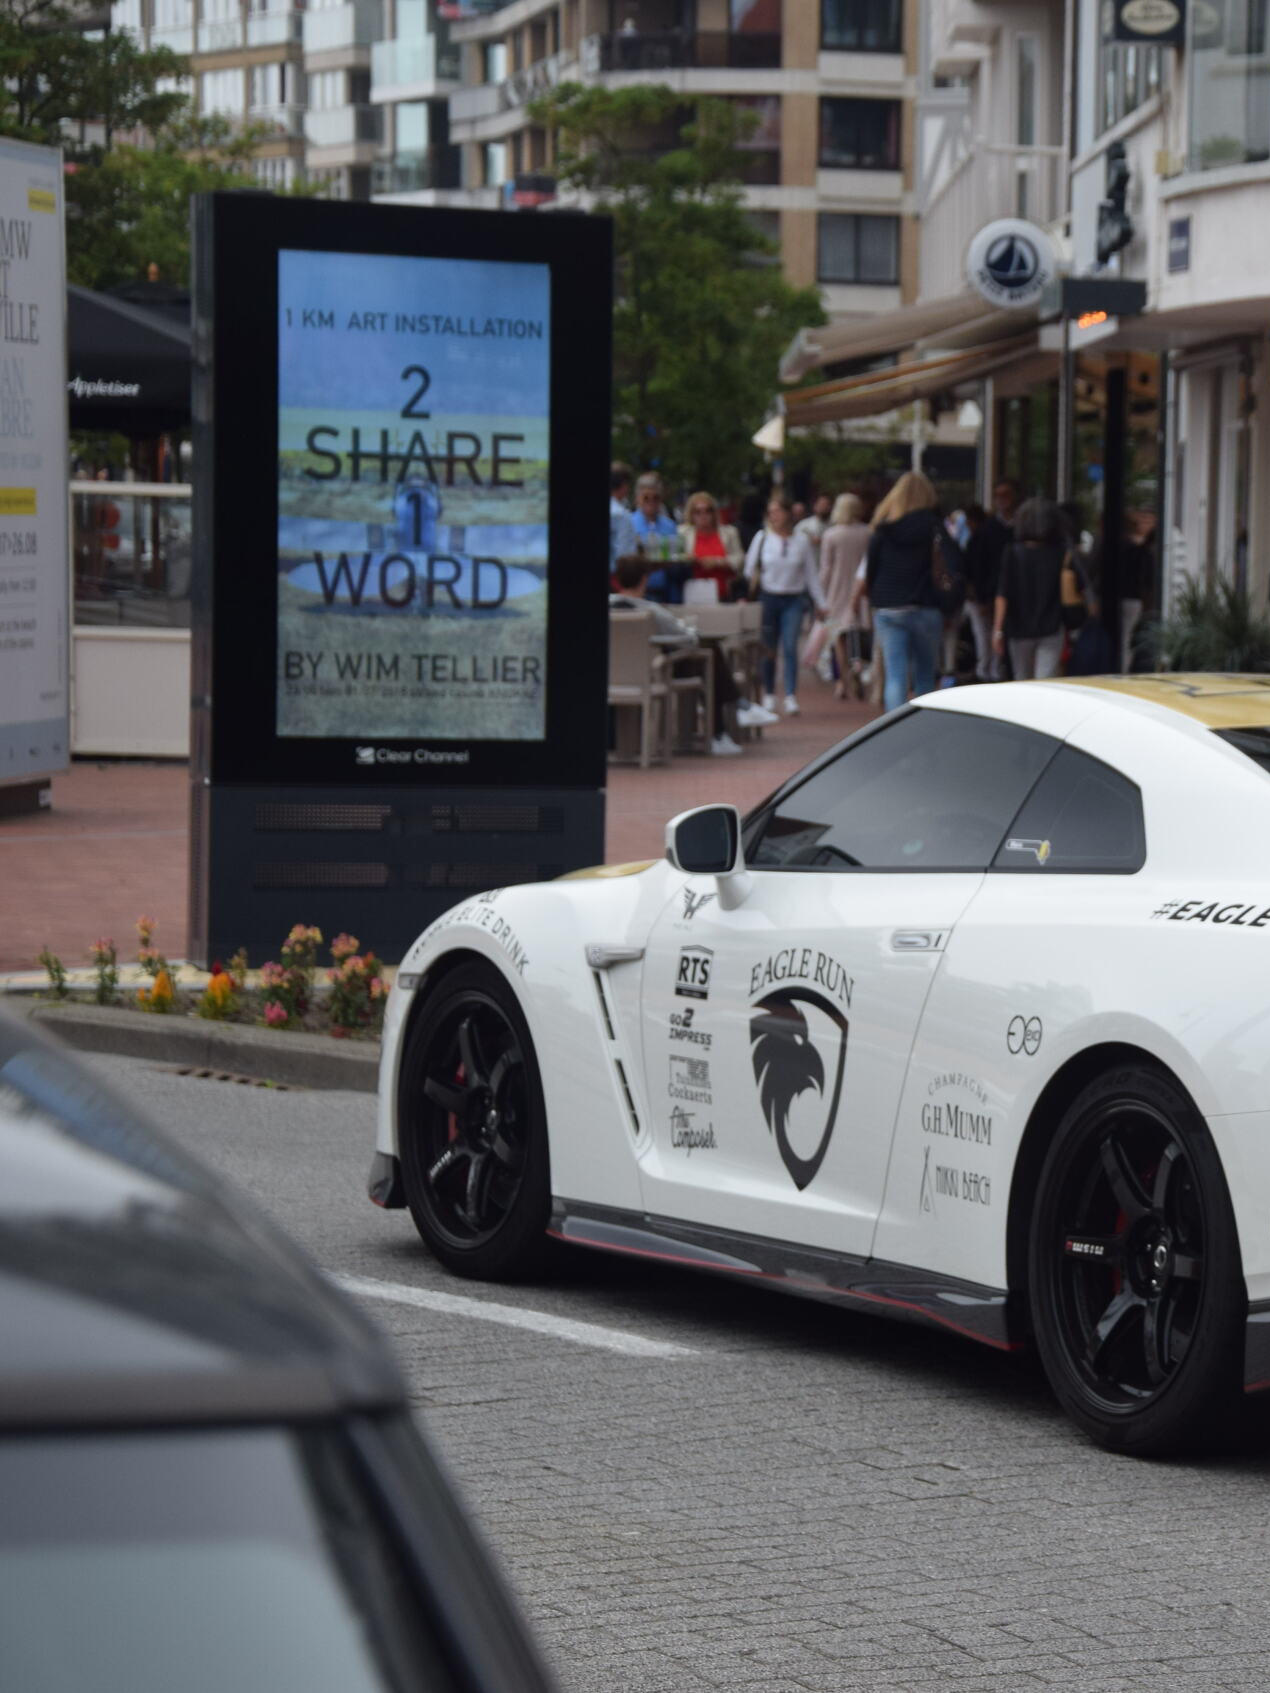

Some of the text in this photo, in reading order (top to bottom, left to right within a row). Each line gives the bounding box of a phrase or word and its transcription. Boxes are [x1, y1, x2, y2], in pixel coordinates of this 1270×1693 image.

[285, 307, 544, 340] 1 KM ART INSTALLATION
[401, 363, 431, 420] 2
[304, 425, 525, 488] SHARE
[410, 496, 424, 546] 1
[313, 551, 508, 610] WORD
[284, 651, 542, 684] BY WIM TELLIER
[491, 917, 530, 977] DRINK
[678, 955, 710, 986] RTS
[748, 947, 854, 1009] EAGLE RUN
[668, 1027, 713, 1046] IMPRESS
